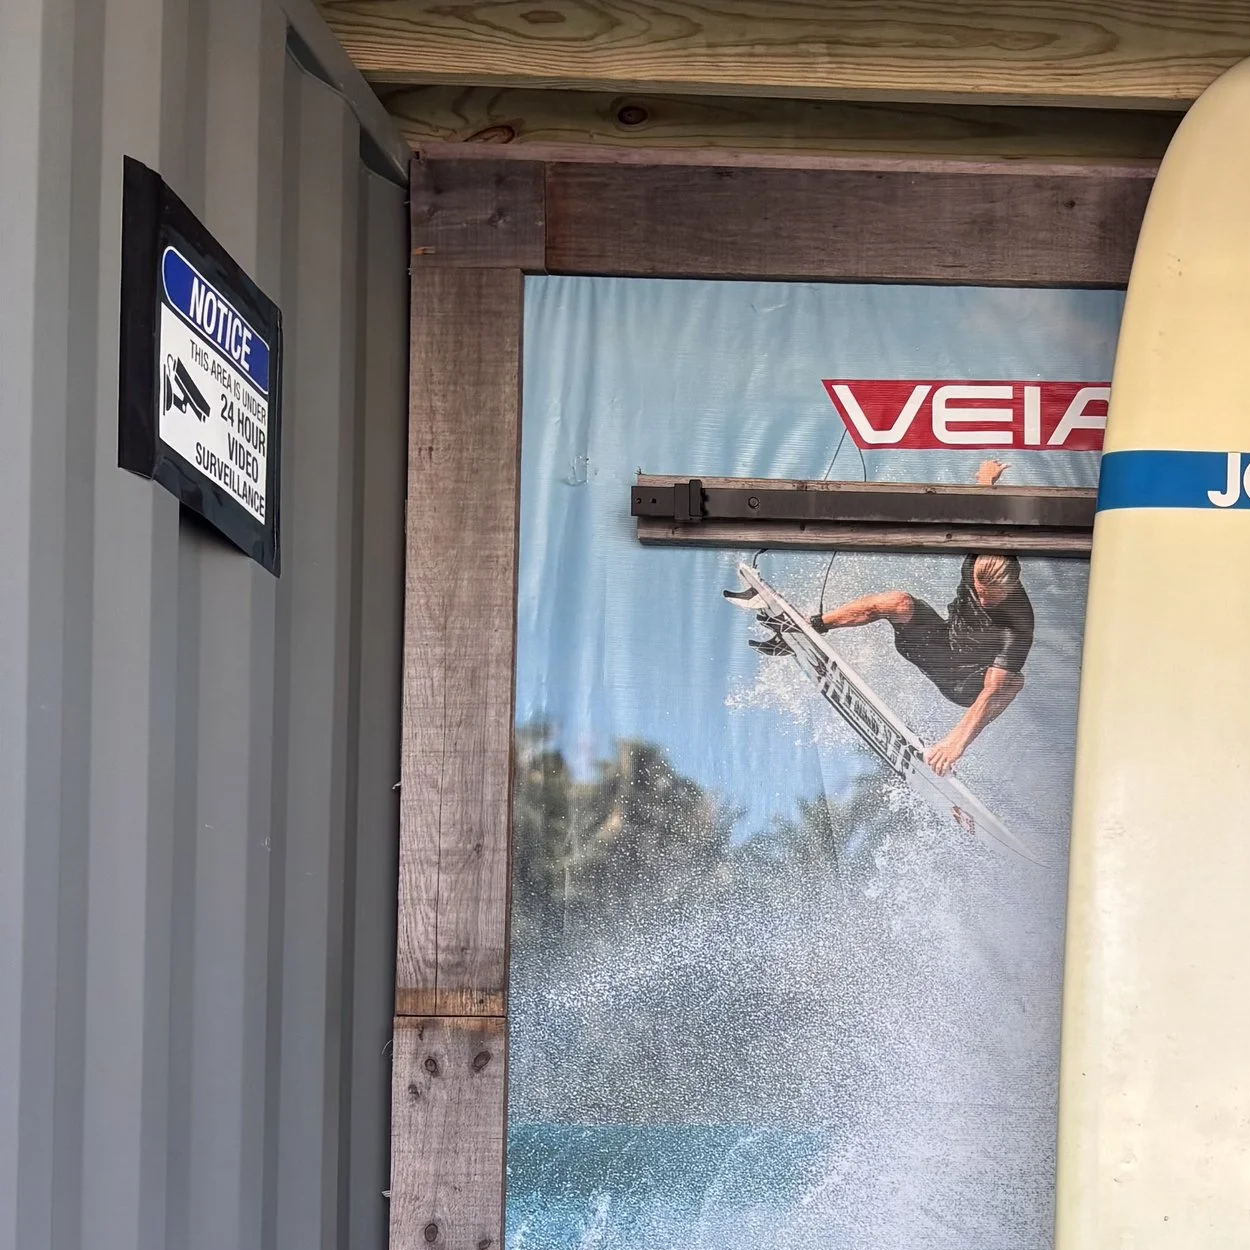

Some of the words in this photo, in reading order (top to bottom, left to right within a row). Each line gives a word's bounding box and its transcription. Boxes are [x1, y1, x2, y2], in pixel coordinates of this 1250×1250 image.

[189, 276, 252, 371] NOTICE
[190, 339, 209, 372] THIS
[211, 358, 232, 393] AREA
[233, 378, 241, 401] IS
[242, 387, 266, 426] UNDER
[220, 393, 235, 427] 24
[237, 408, 266, 457] HOUR
[227, 432, 259, 483] VIDEO
[195, 441, 265, 517] SURVEILLANCE
